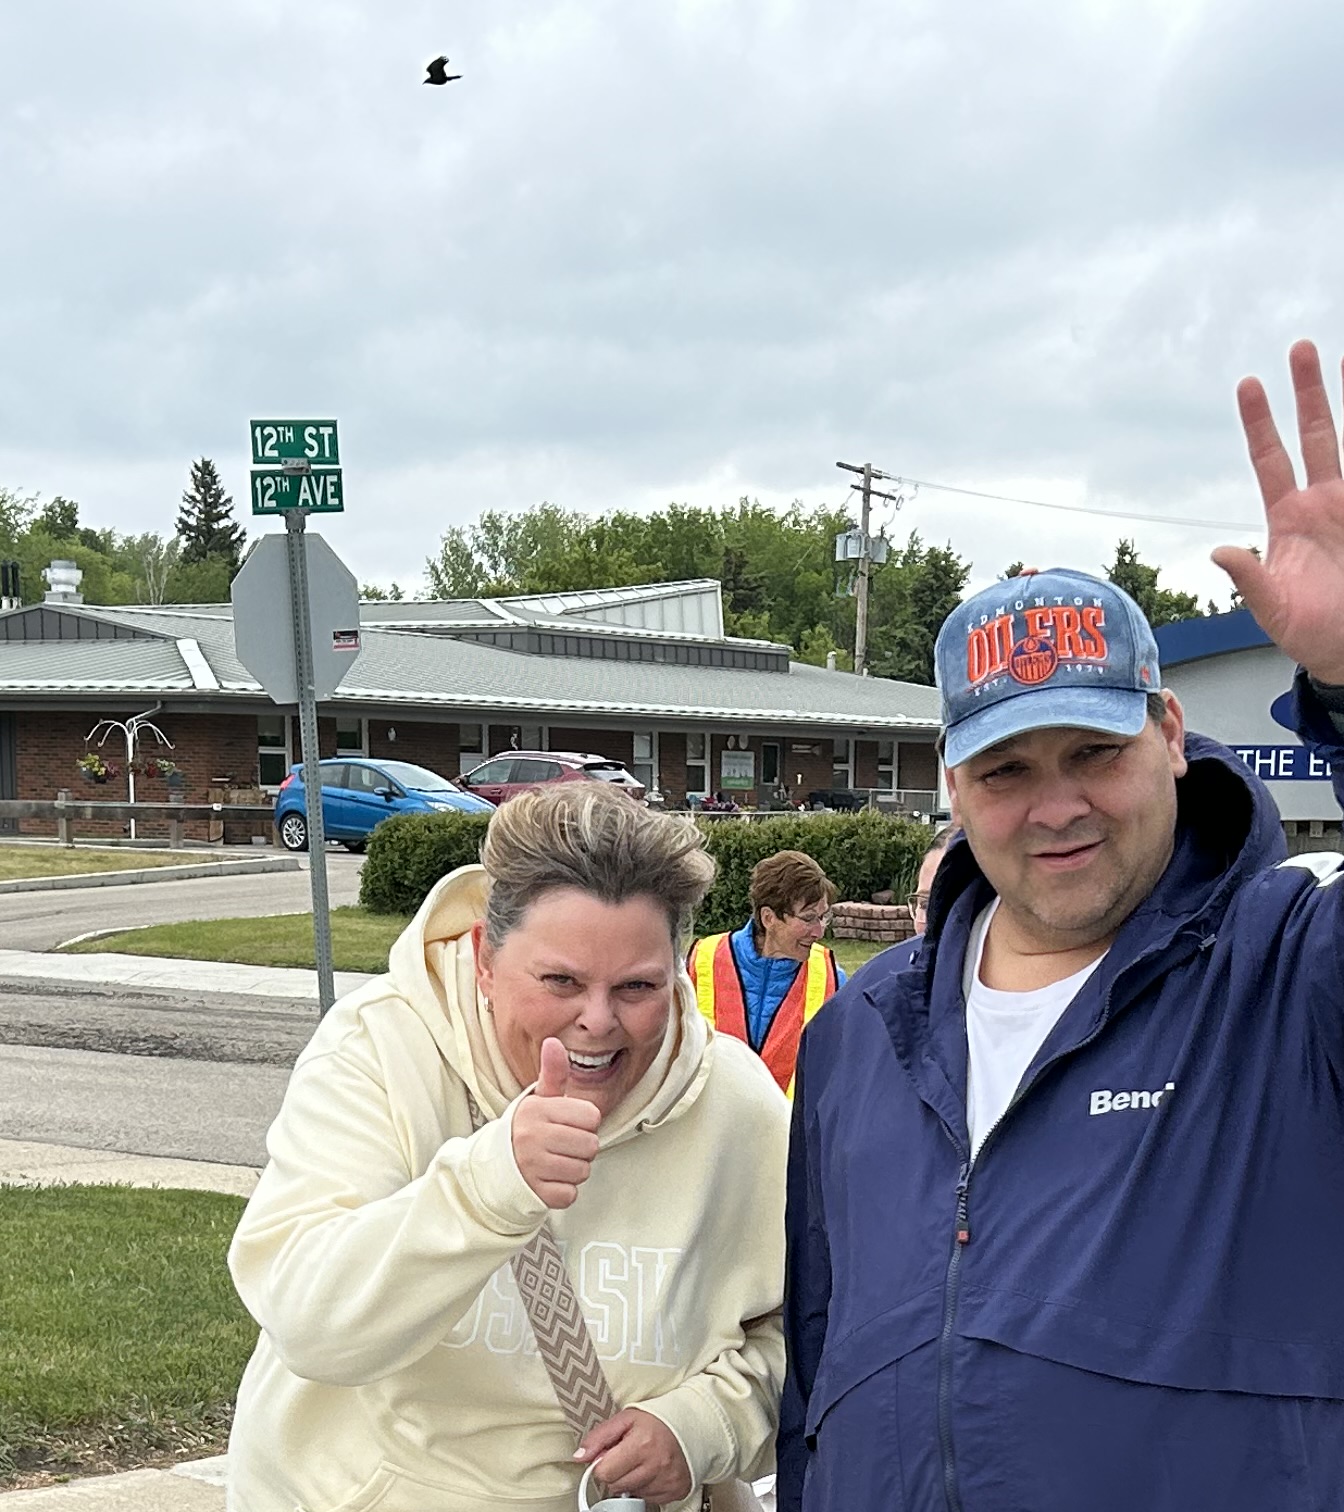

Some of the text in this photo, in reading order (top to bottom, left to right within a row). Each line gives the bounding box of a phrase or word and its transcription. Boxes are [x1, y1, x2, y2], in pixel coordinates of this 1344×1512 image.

[255, 426, 333, 457] 12TH ST
[255, 475, 339, 507] 12TH AVE
[968, 606, 1108, 684] OILERS
[1236, 749, 1294, 776] THE
[1090, 1082, 1175, 1115] Benc
